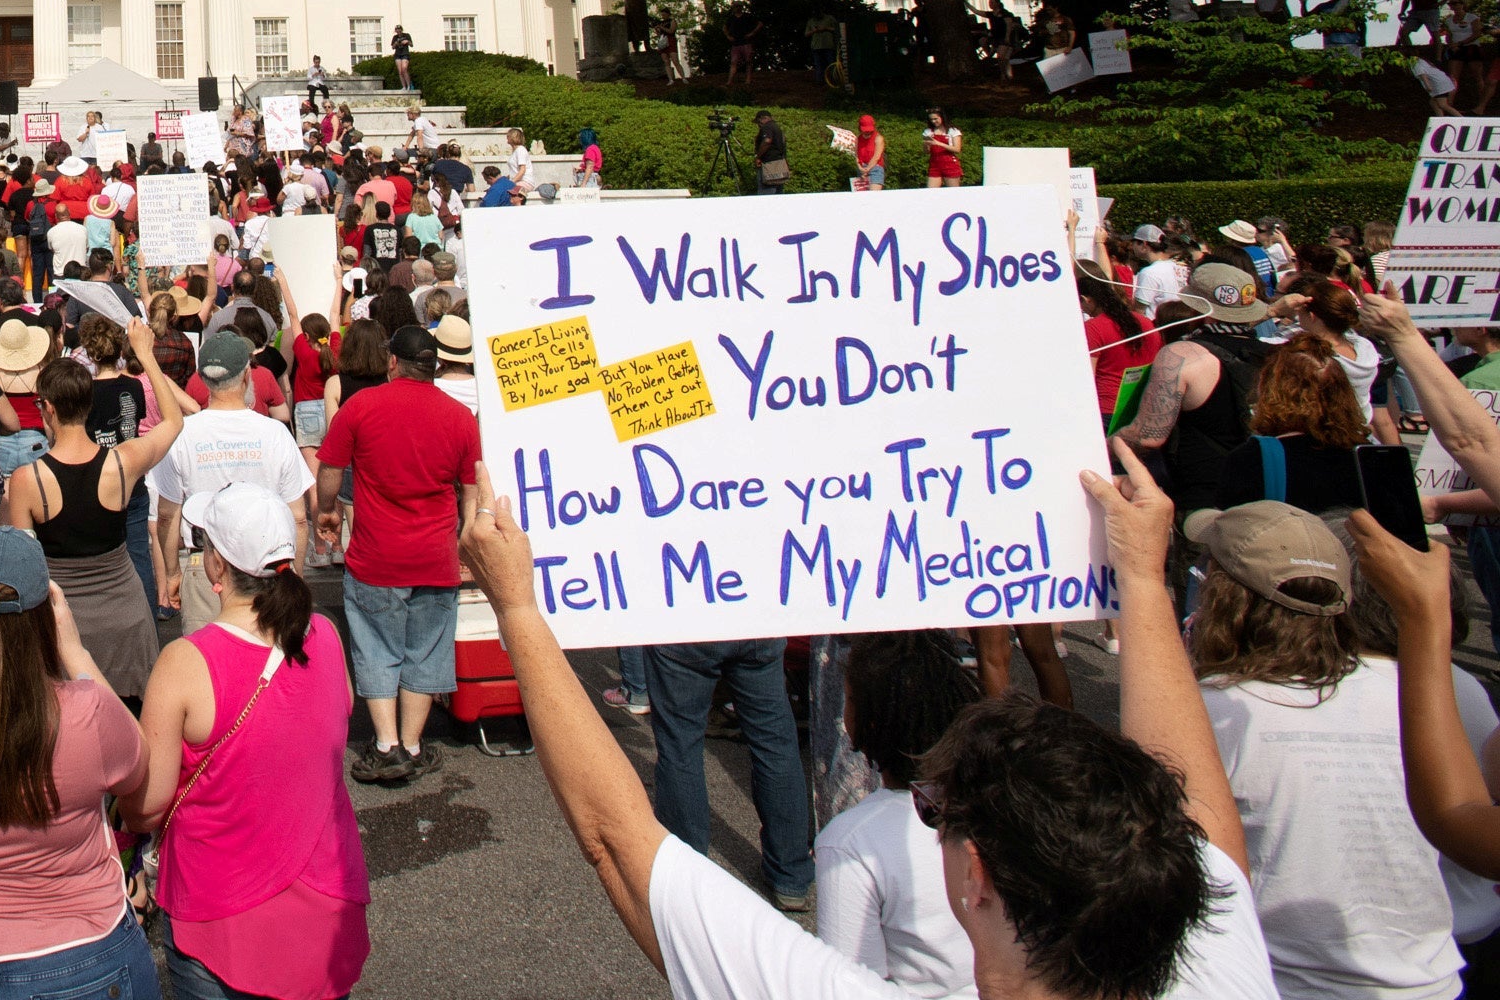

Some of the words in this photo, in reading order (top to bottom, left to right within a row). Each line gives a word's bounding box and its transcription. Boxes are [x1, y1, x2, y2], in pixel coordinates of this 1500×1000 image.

[28, 114, 51, 122] PROTECT
[1430, 124, 1500, 154] QUE
[529, 235, 597, 310] I
[616, 231, 766, 305] Walk
[778, 231, 839, 305] In
[850, 227, 926, 326] My
[937, 212, 1062, 298] Shoes
[1219, 294, 1233, 304] H8
[1220, 286, 1235, 295] NO
[491, 336, 533, 356] Cancer
[533, 327, 549, 347] Is
[549, 324, 590, 341] Living
[496, 352, 547, 371] Growing
[550, 340, 586, 357] Cells
[497, 372, 521, 389] Put
[525, 368, 539, 380] In
[539, 363, 565, 377] Your
[565, 356, 597, 371] Body
[597, 368, 627, 385] But
[629, 360, 654, 375] You
[656, 348, 689, 364] Have
[717, 330, 827, 421] You
[834, 333, 968, 406] Don't
[507, 391, 526, 404] By
[531, 383, 559, 399] Your
[567, 372, 590, 393] god
[607, 391, 623, 406] No
[626, 374, 666, 395] Problem
[667, 362, 701, 381] Getting
[611, 401, 650, 418] Them
[654, 390, 675, 404] Cut
[680, 380, 703, 394] out
[628, 417, 663, 435] Think
[665, 402, 697, 426] About
[696, 399, 713, 417] It
[195, 442, 215, 452] Get
[216, 439, 262, 450] Covered
[513, 447, 621, 532] How
[632, 443, 769, 519] Dare
[784, 470, 872, 524] you
[883, 436, 963, 518] Try
[971, 427, 1033, 495] To
[1414, 468, 1475, 490] SMILI
[533, 549, 628, 615] Tell
[661, 540, 748, 607] Me
[780, 524, 862, 621] My
[875, 508, 1051, 601] Medical
